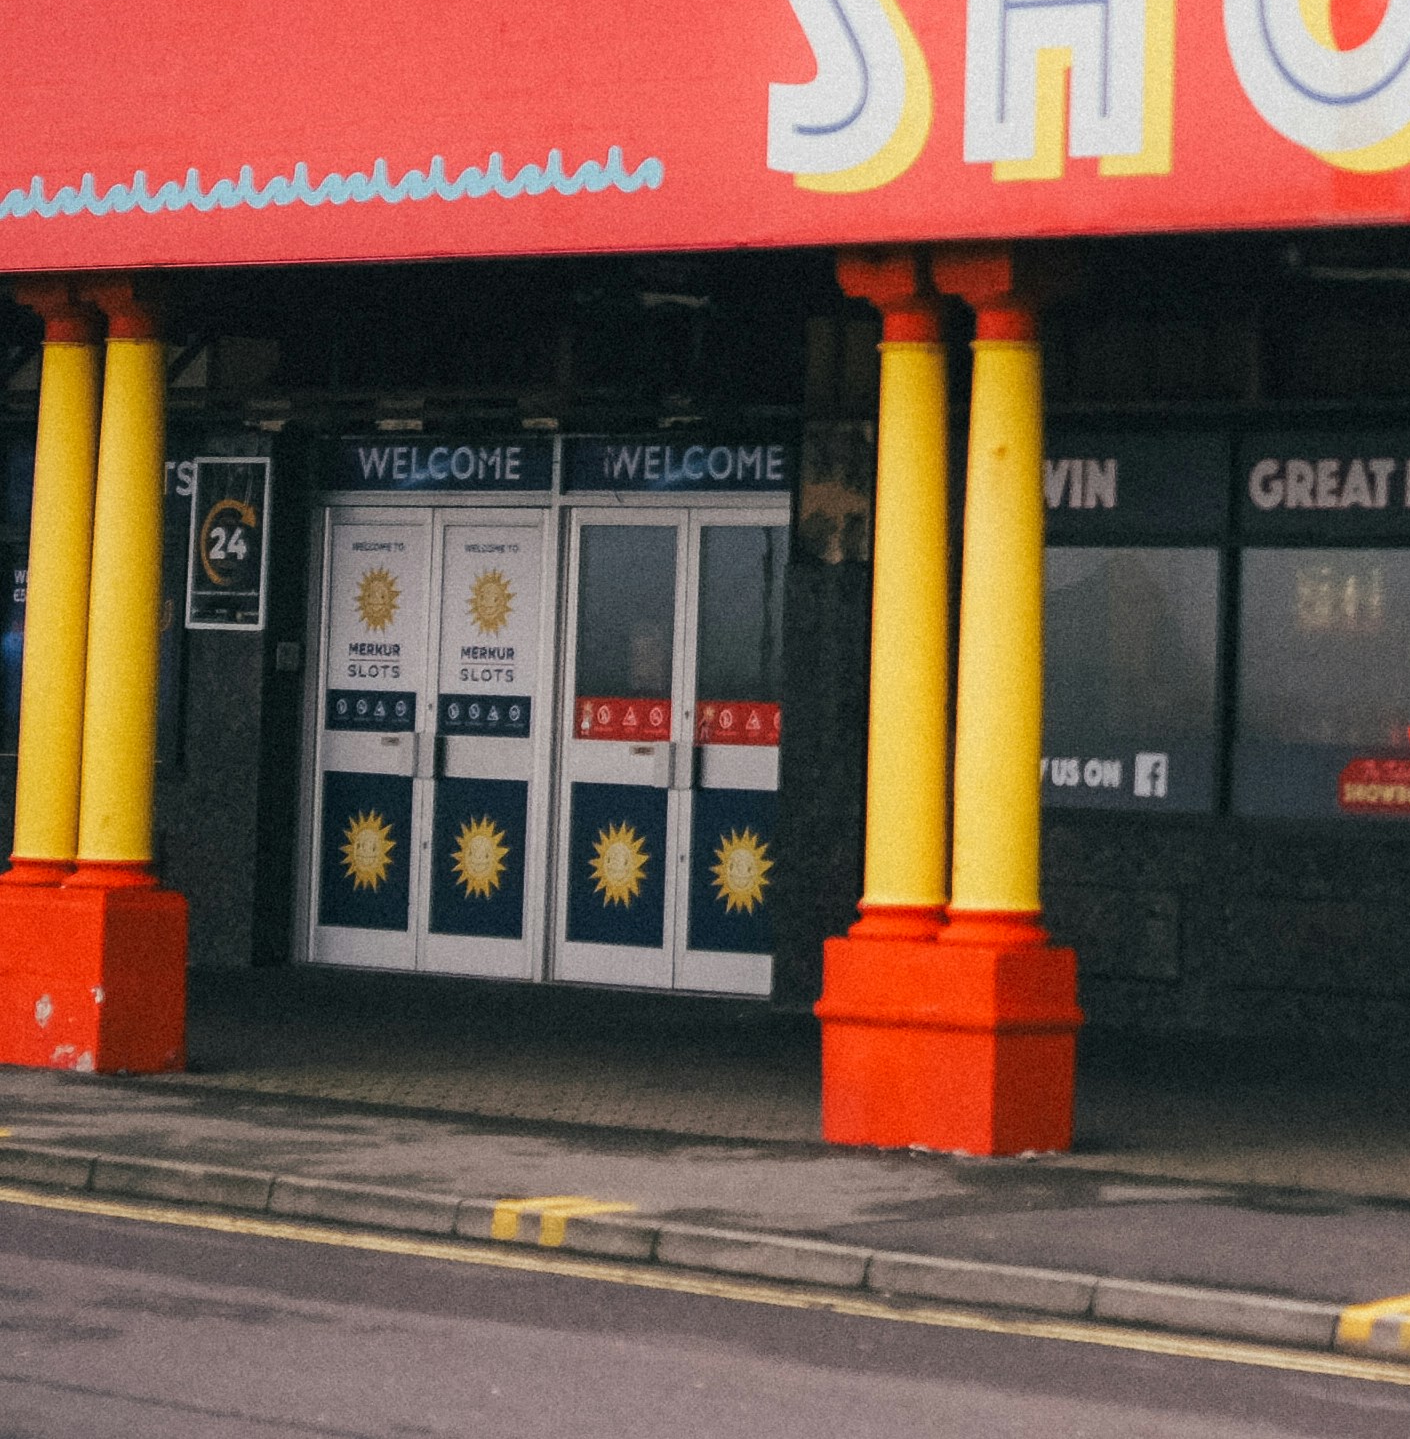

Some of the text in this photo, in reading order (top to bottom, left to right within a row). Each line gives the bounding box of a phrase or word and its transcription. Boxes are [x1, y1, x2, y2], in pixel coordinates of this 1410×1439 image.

[357, 446, 522, 481] WELCOME
[610, 444, 786, 481] WELCOME
[1249, 458, 1396, 510] GREAT
[209, 526, 247, 560] 24
[348, 643, 401, 657] MERKUR
[460, 646, 515, 660] MERKUR
[347, 664, 401, 679] SLOTS
[459, 668, 514, 682] SLOTS
[1051, 758, 1079, 787] US
[1083, 760, 1121, 788] ON
